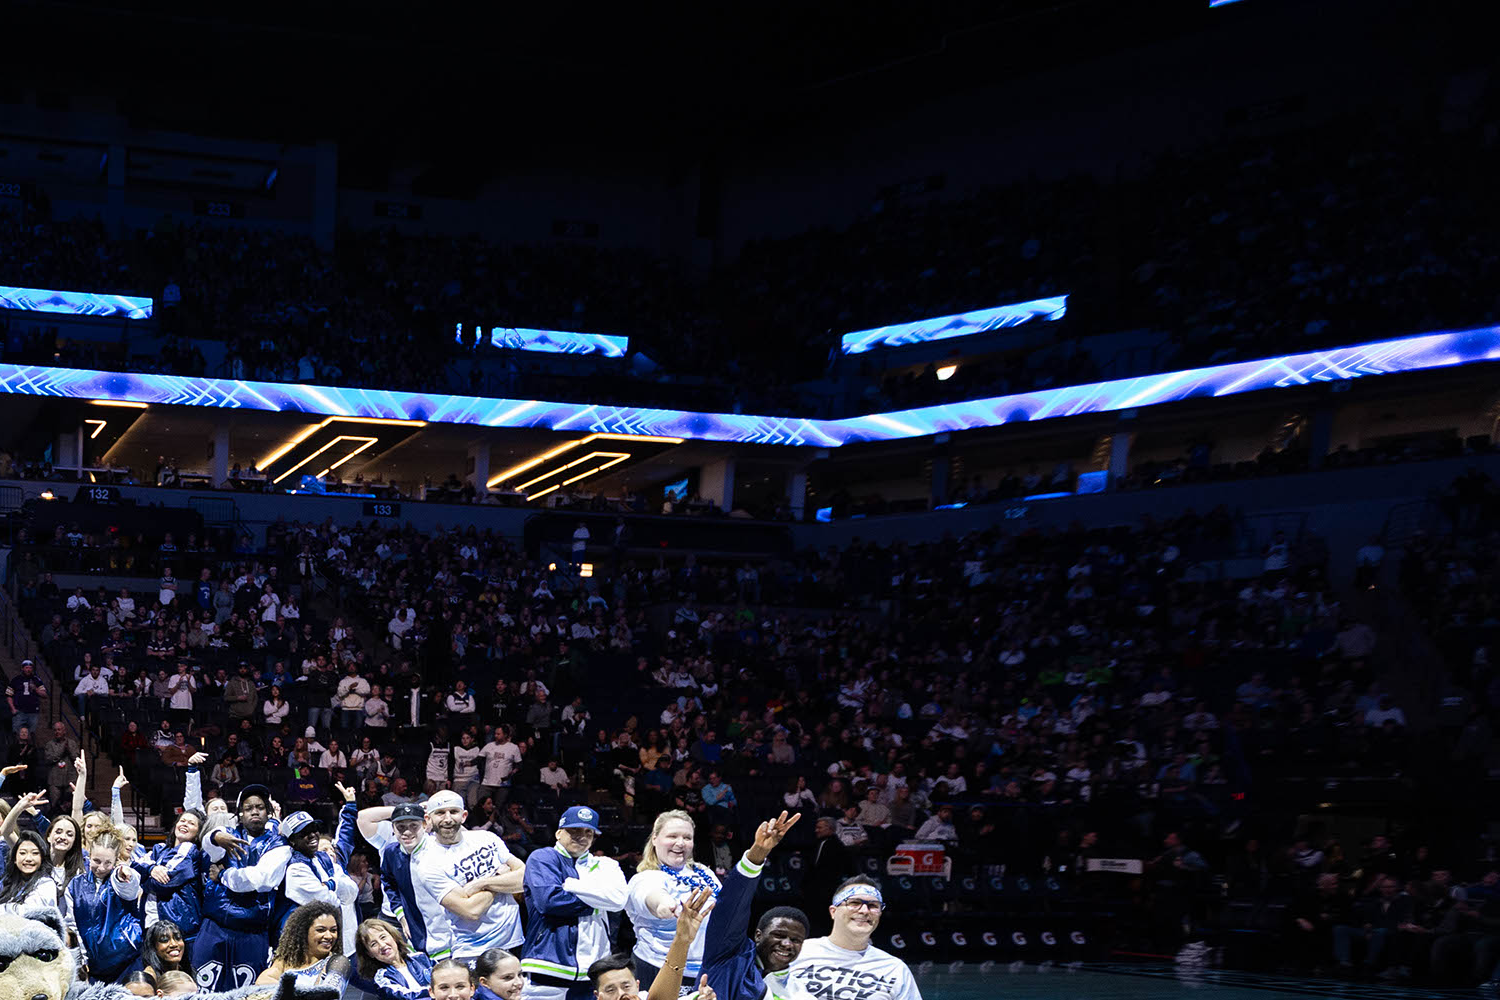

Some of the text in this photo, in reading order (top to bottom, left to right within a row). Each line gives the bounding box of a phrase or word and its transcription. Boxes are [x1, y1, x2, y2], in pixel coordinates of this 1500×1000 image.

[89, 489, 109, 500] 132
[374, 505, 392, 515] 133
[922, 853, 934, 865] G
[890, 933, 907, 949] G
[921, 931, 937, 946] G
[952, 931, 968, 946] G
[982, 931, 998, 946] G
[1011, 931, 1027, 946] G
[1041, 931, 1057, 945] G
[1070, 931, 1086, 945] G
[796, 964, 898, 994] ACTION
